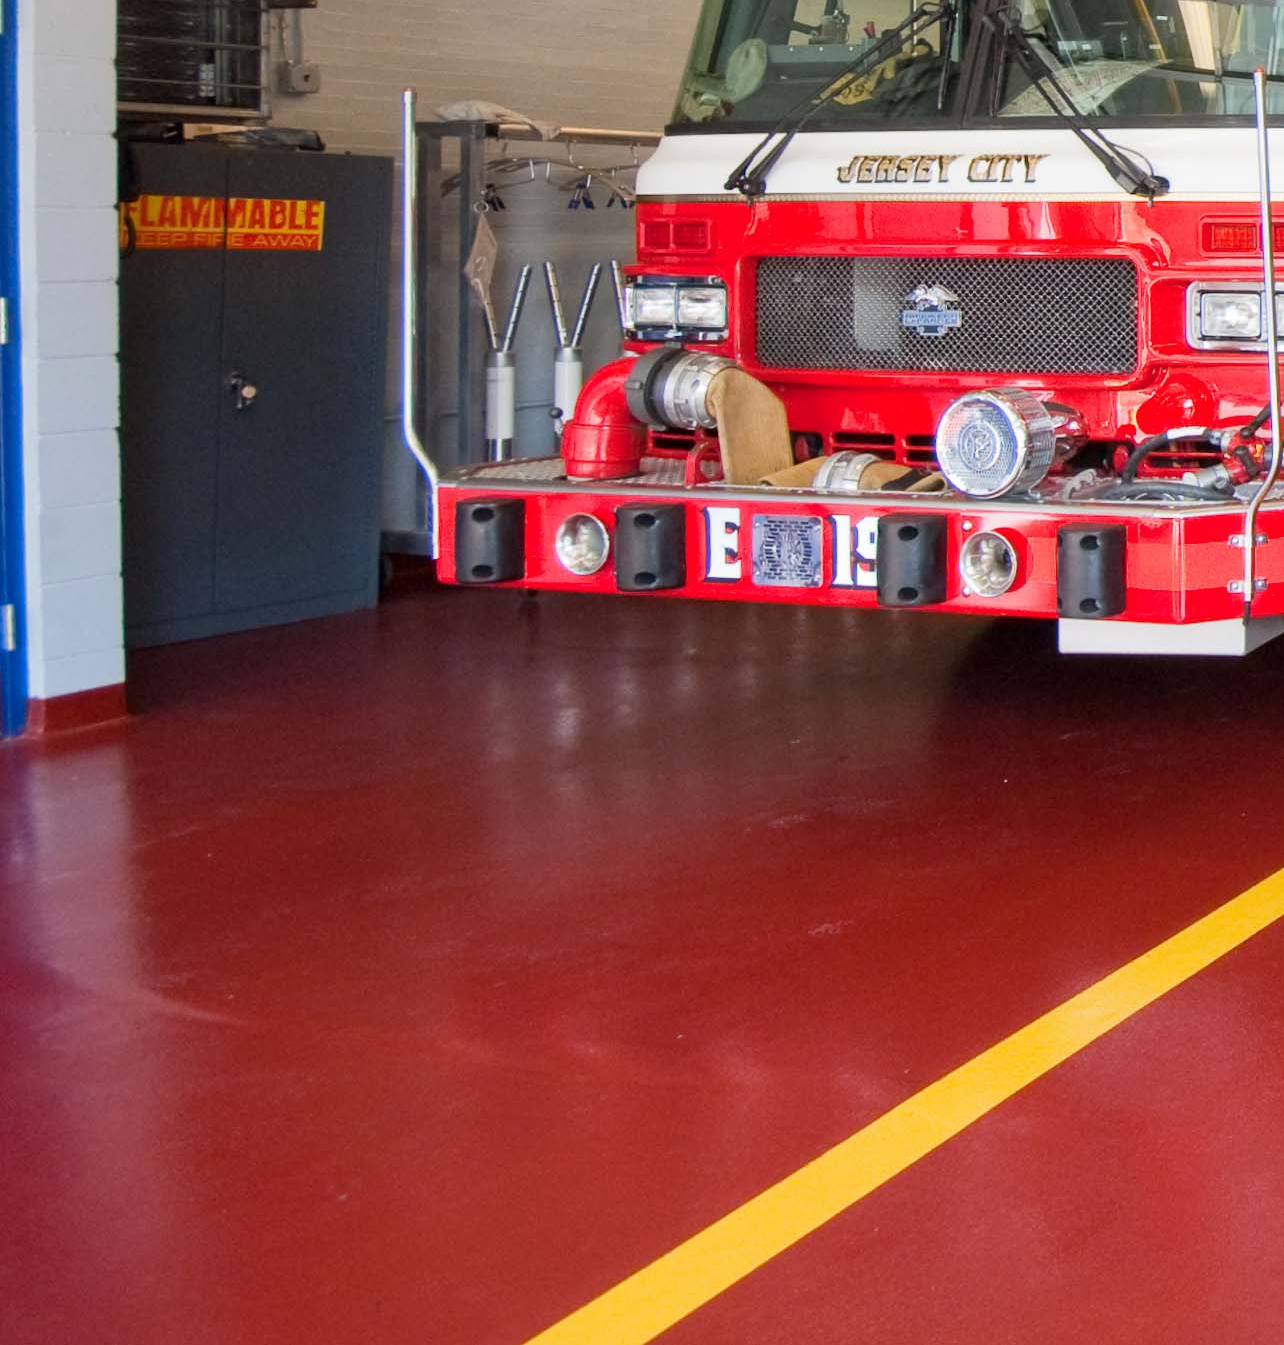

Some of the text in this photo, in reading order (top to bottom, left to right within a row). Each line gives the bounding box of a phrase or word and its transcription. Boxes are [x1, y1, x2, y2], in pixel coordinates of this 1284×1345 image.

[836, 154, 1052, 183] JERSEY CITY
[135, 232, 188, 247] EEP
[252, 234, 317, 248] AWAY
[704, 507, 742, 583] E
